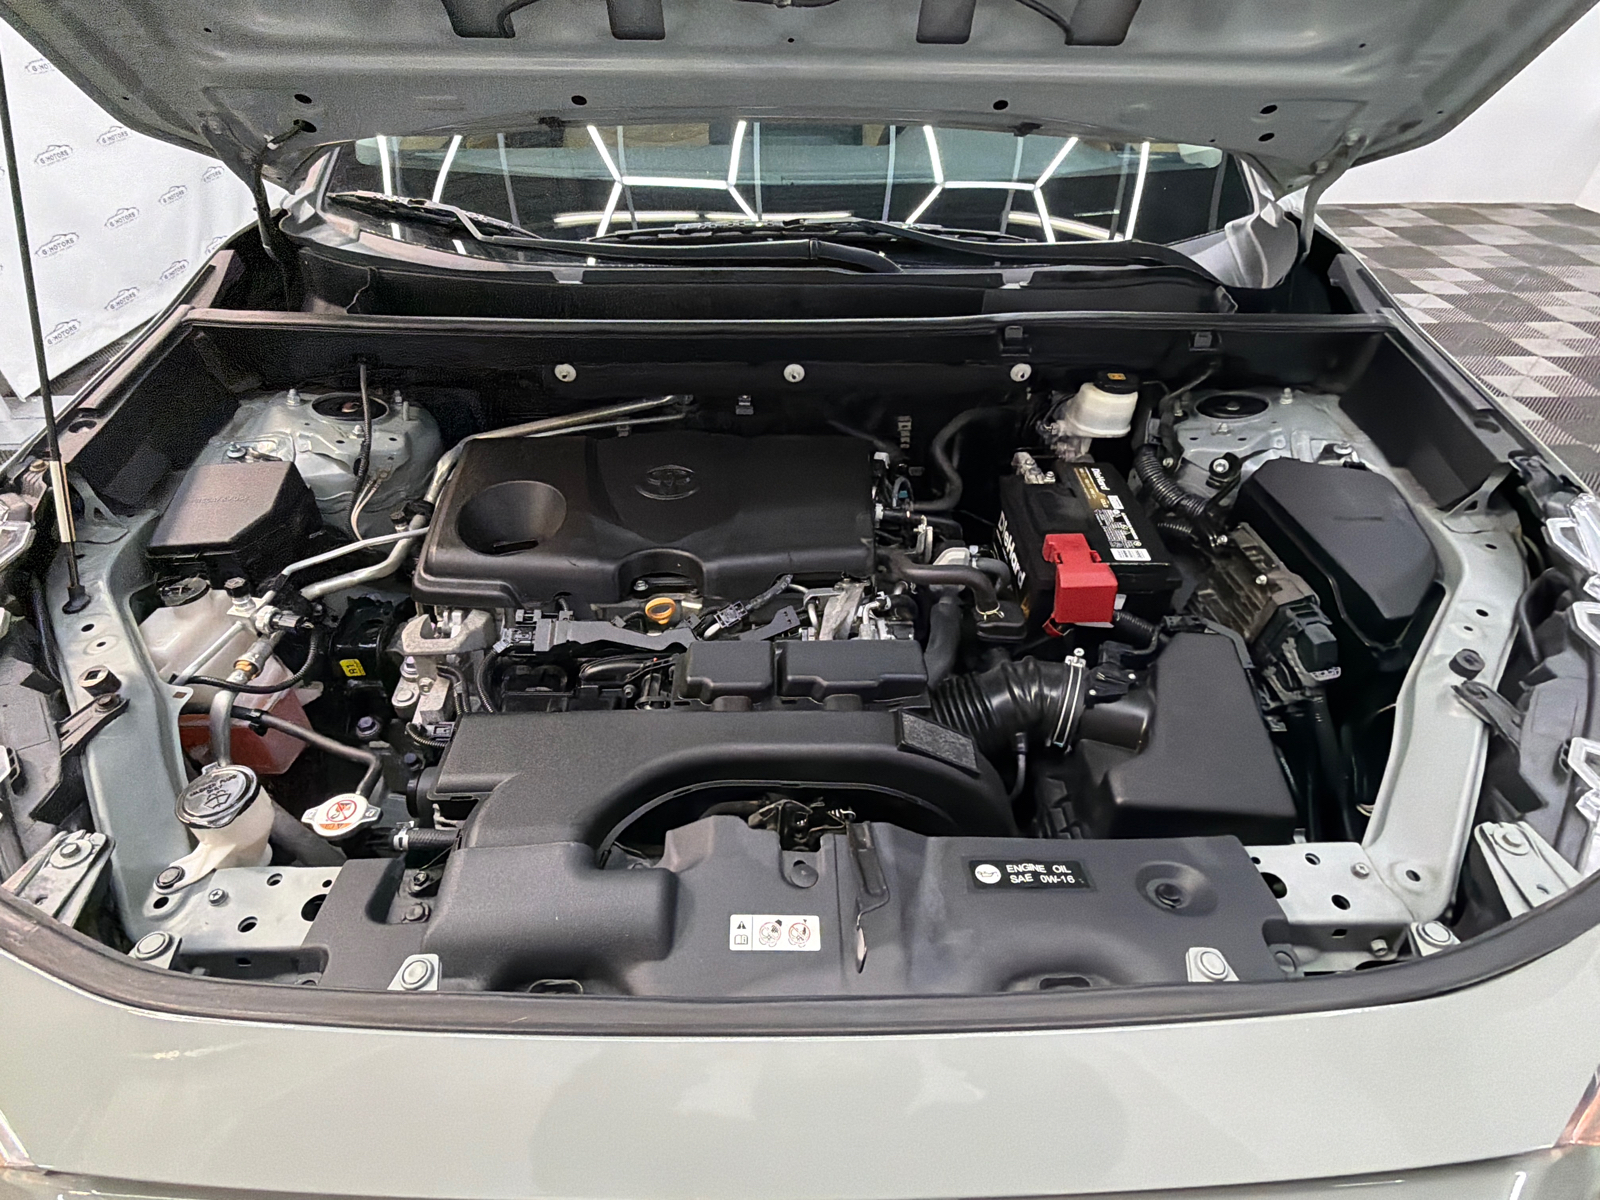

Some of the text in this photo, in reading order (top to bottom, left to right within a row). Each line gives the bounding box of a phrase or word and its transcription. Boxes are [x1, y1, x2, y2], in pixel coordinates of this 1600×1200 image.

[107, 130, 129, 141] MOTORS
[46, 149, 69, 161] MOTORS
[115, 212, 136, 224] MOTORS
[48, 237, 75, 253] MOTORS
[116, 292, 137, 306] MOTORS
[53, 324, 78, 341] MOTORS
[1091, 468, 1110, 490] DieHard
[998, 510, 1026, 589] DieHard
[1005, 863, 1072, 874] ENGINE OIL
[1009, 873, 1076, 884] SAE 0W-16
